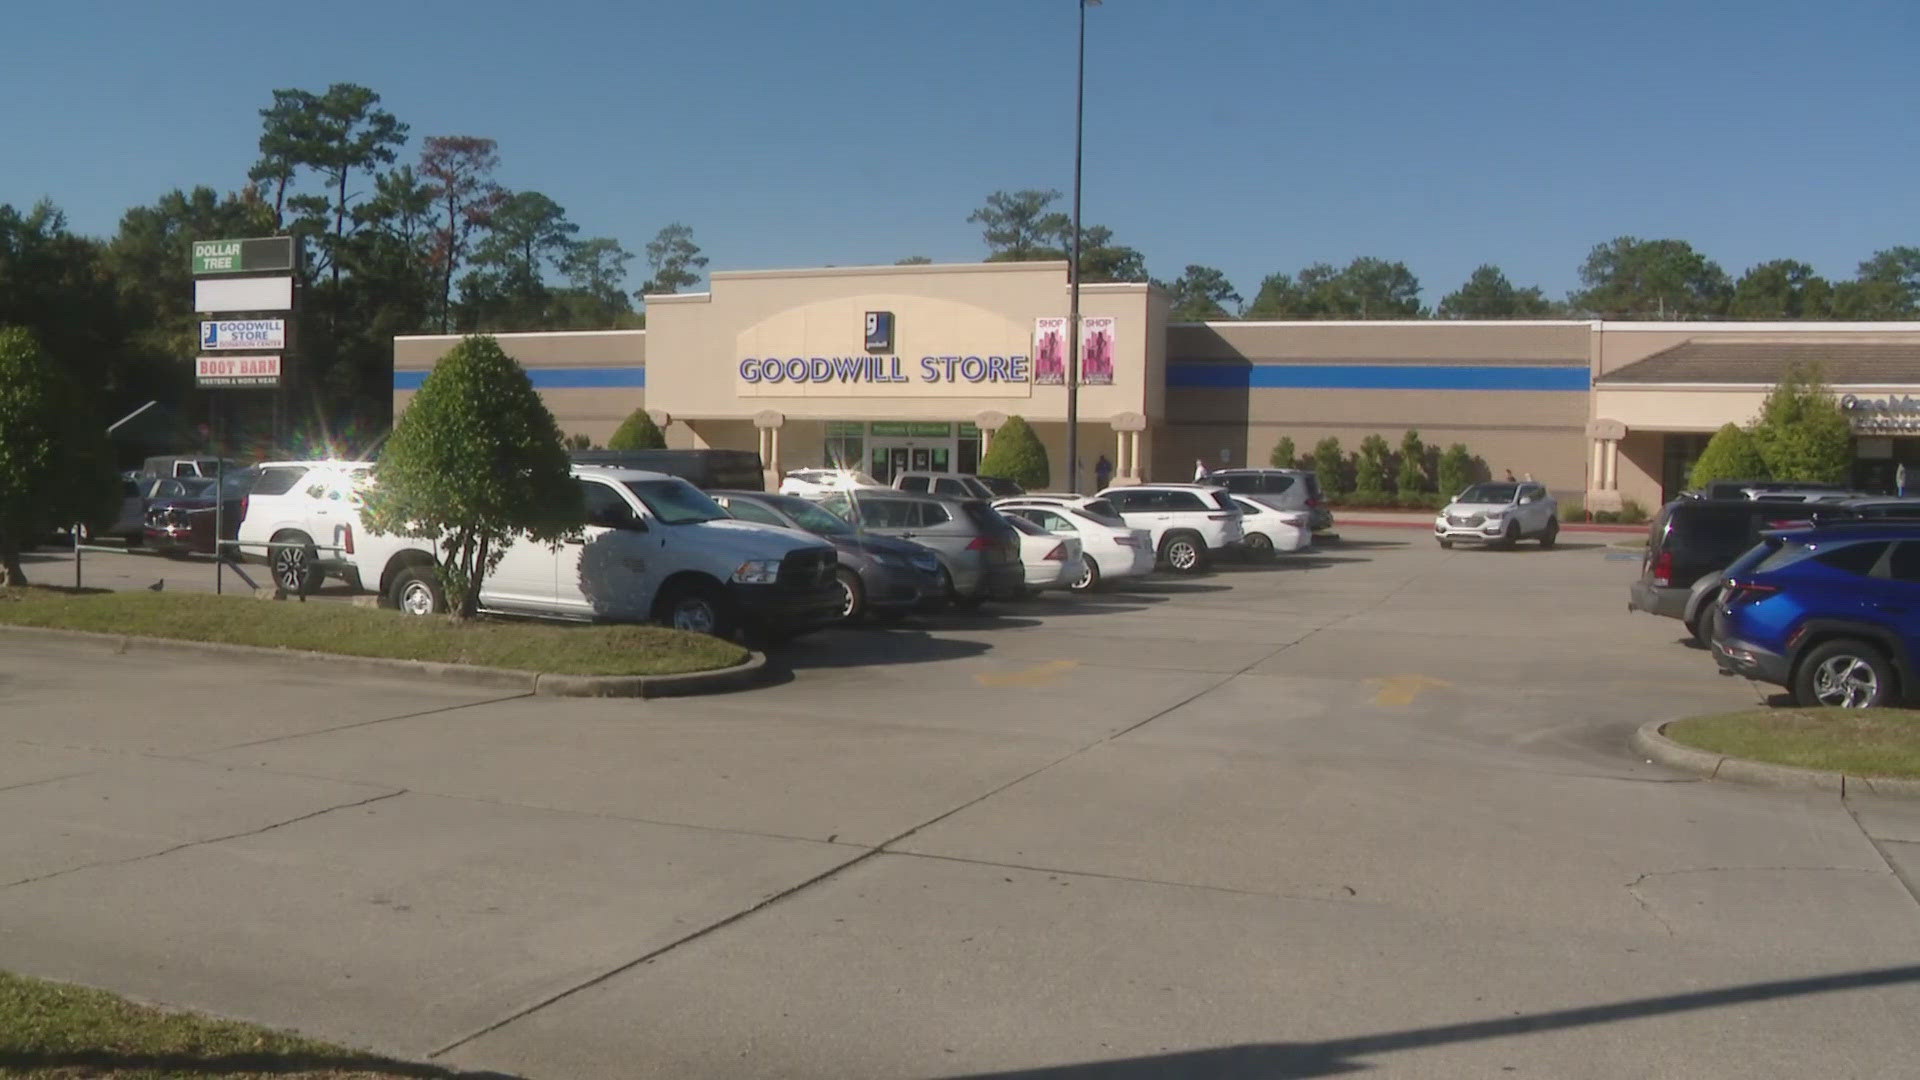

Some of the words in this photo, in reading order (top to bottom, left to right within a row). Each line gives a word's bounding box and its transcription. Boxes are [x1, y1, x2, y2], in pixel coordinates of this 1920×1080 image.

[195, 243, 240, 257] DOLLAR
[203, 257, 232, 270] TREE
[219, 322, 281, 332] GOODWILL
[1039, 319, 1063, 327] SHOP
[1085, 319, 1111, 327] SHOP
[231, 331, 268, 341] STORE
[200, 361, 235, 374] BOOT
[240, 359, 277, 373] BARN
[739, 356, 909, 382] GOODWILL
[920, 355, 1029, 382] STORE
